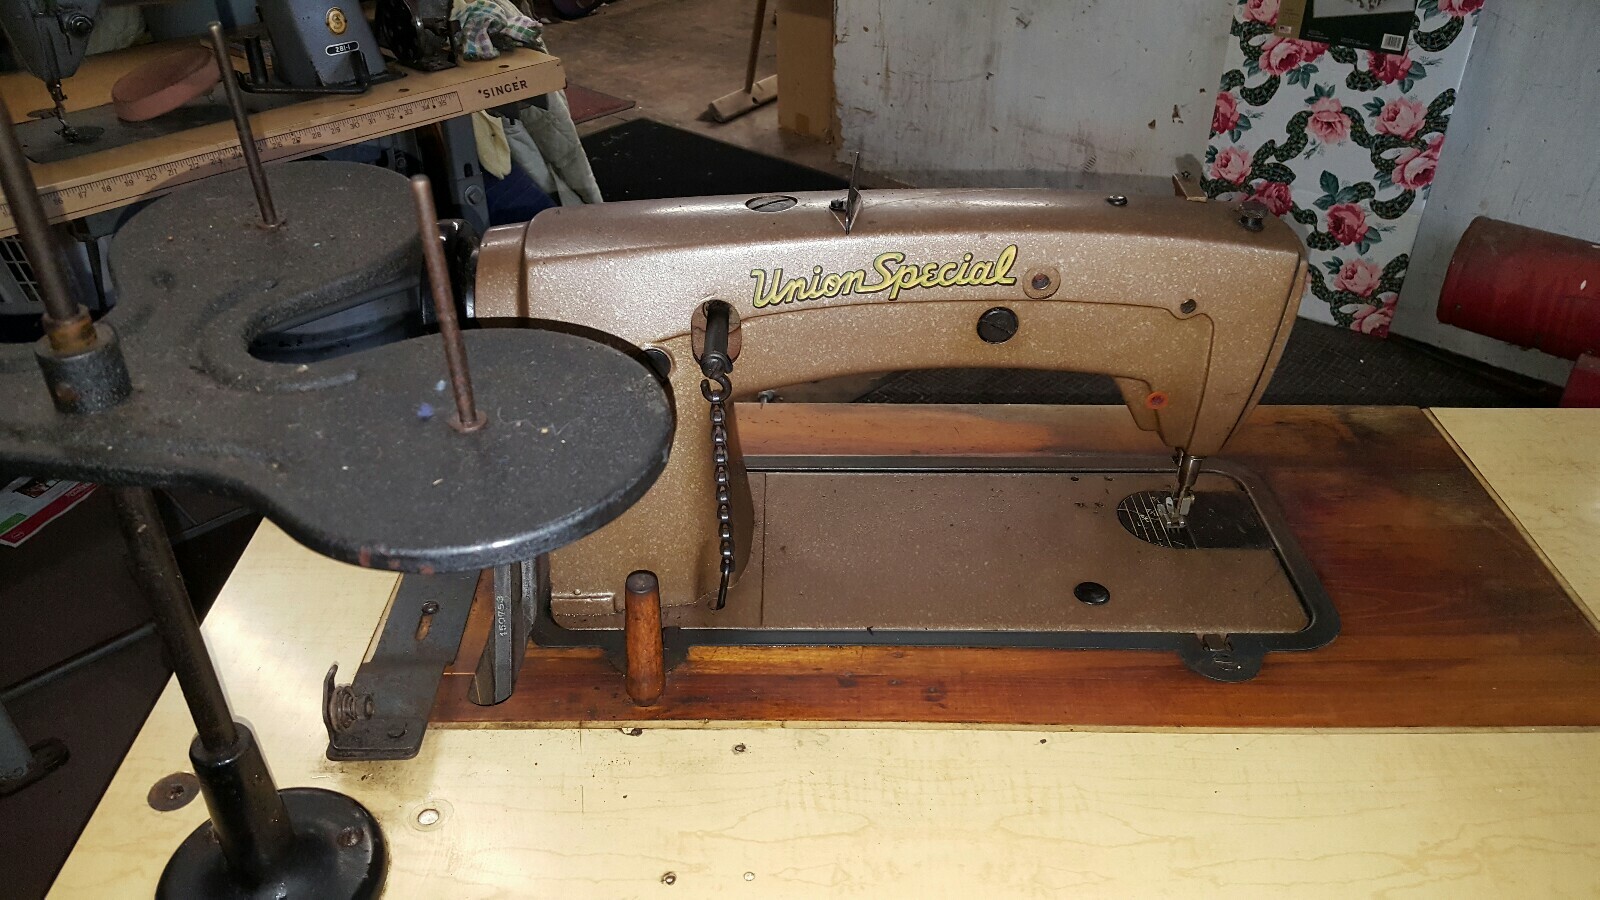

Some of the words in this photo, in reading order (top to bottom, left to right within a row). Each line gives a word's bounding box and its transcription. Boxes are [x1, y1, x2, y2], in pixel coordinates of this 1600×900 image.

[335, 44, 350, 53] 281-1
[482, 79, 528, 99] SINGER
[101, 185, 112, 193] 18
[145, 174, 157, 182] 20
[168, 168, 178, 176] 21
[330, 127, 340, 135] 29
[350, 122, 360, 130] 30
[368, 118, 377, 126] 31
[404, 108, 413, 116] 33
[750, 266, 867, 308] Union
[872, 244, 1017, 300] Special
[496, 595, 508, 637] 150753
